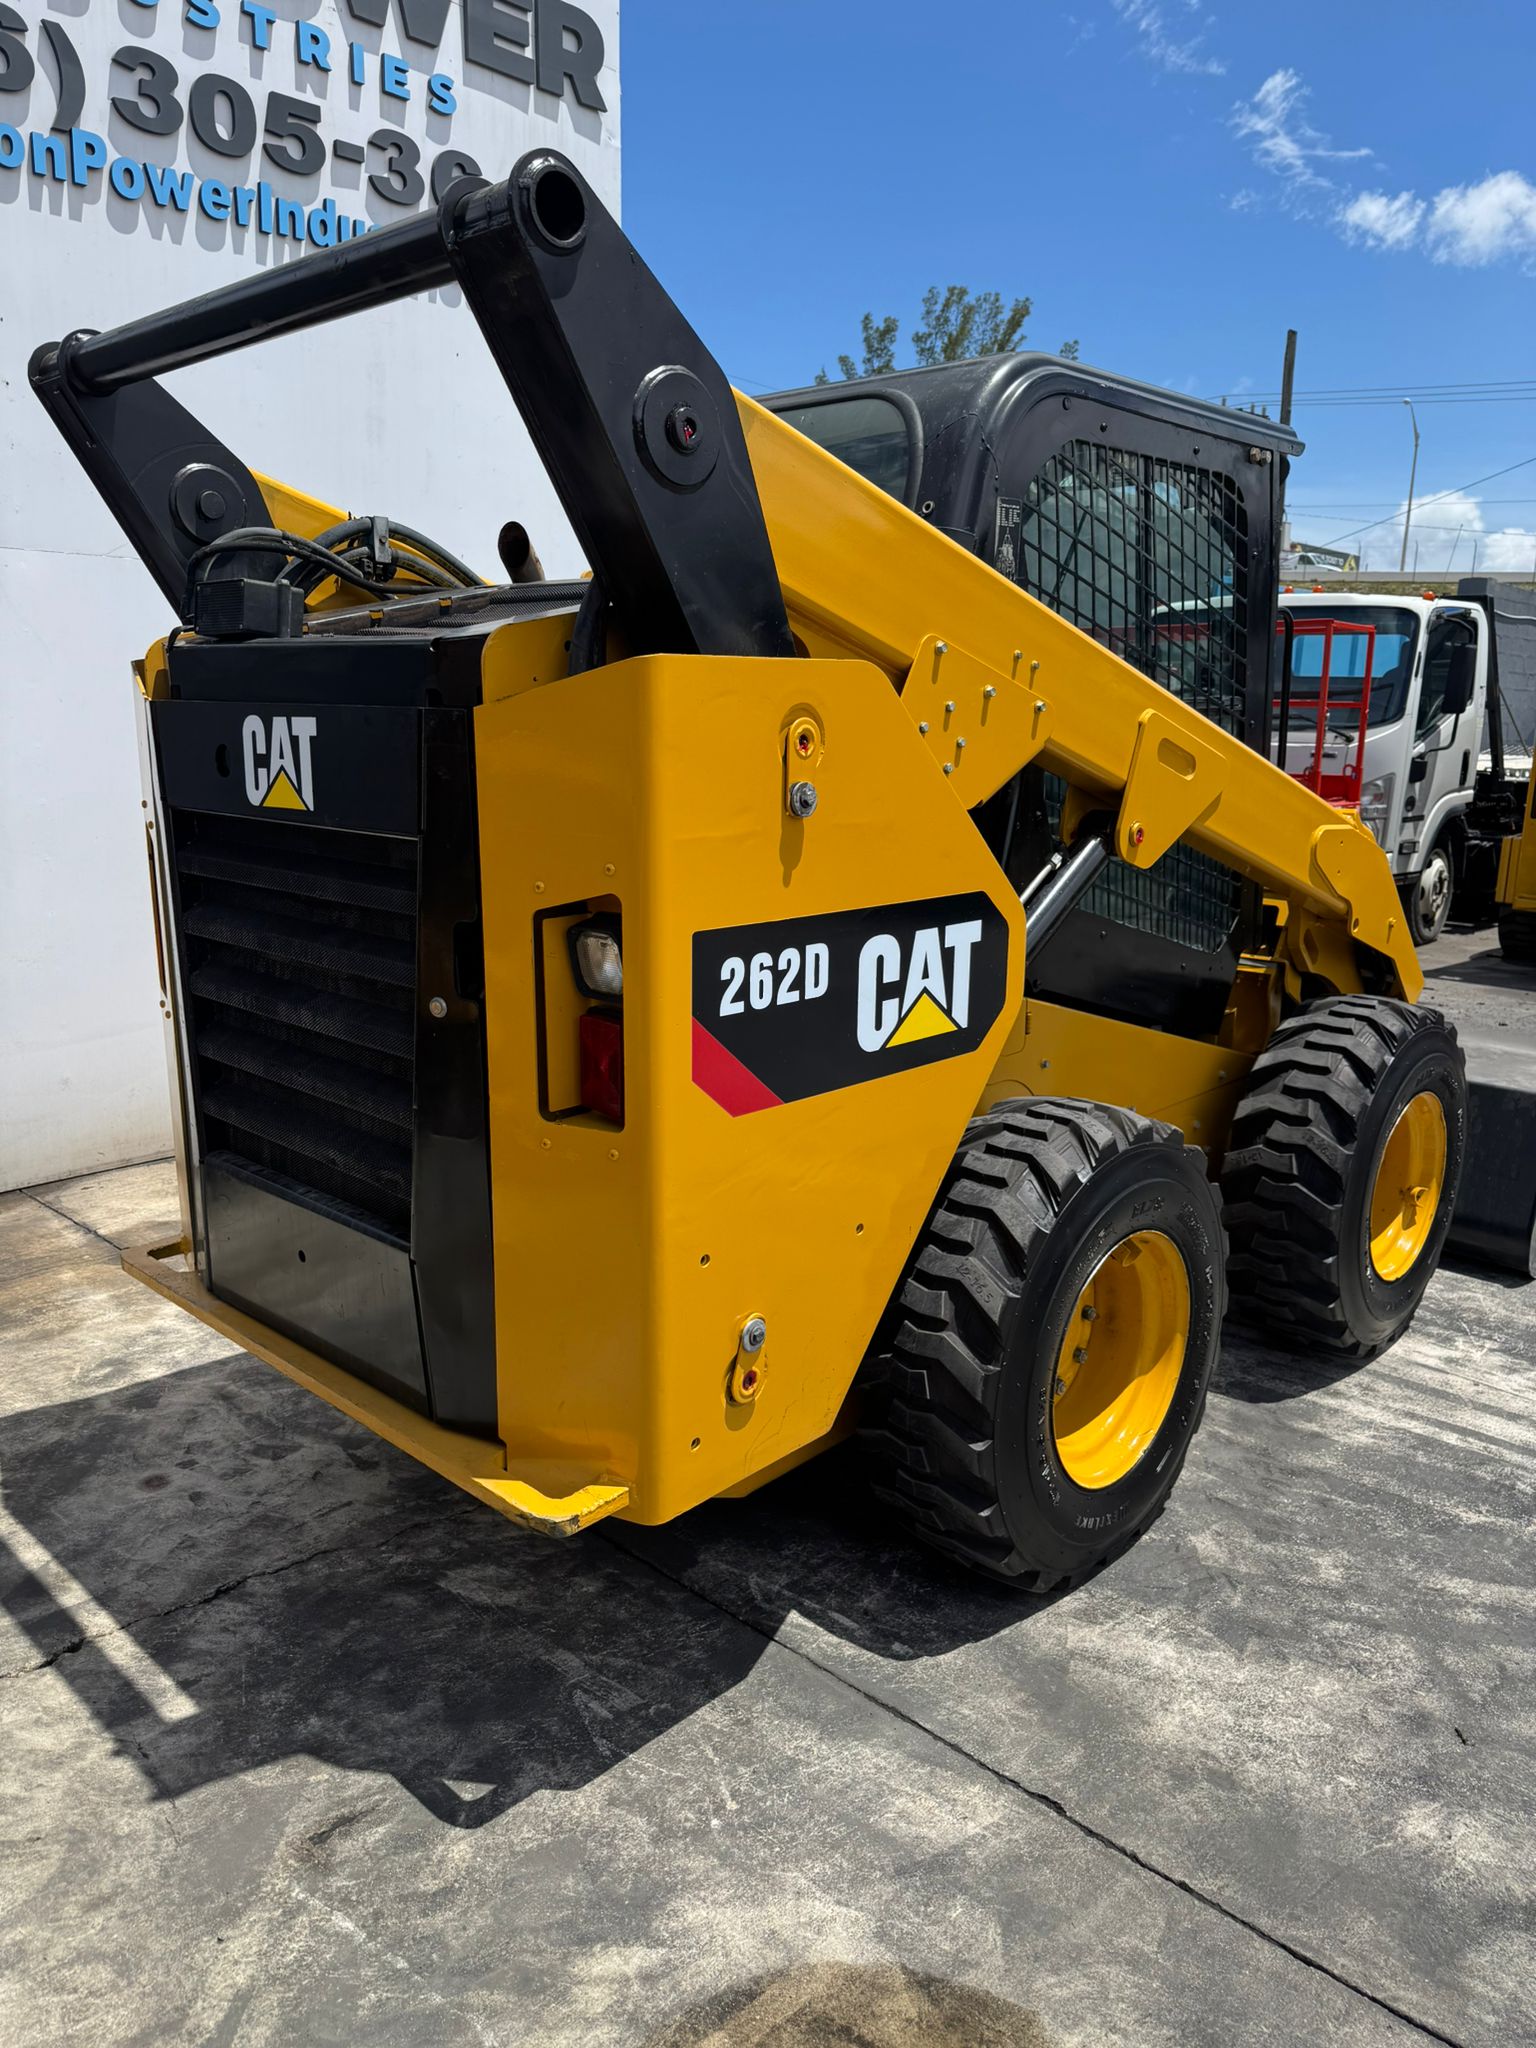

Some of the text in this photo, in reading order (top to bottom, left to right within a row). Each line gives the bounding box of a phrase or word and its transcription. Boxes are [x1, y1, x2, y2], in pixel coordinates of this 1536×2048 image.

[130, 0, 457, 116] STRIES
[0, 123, 383, 247] onPowerIndu
[242, 714, 317, 811] CAT
[719, 919, 983, 1053] 262D CAT
